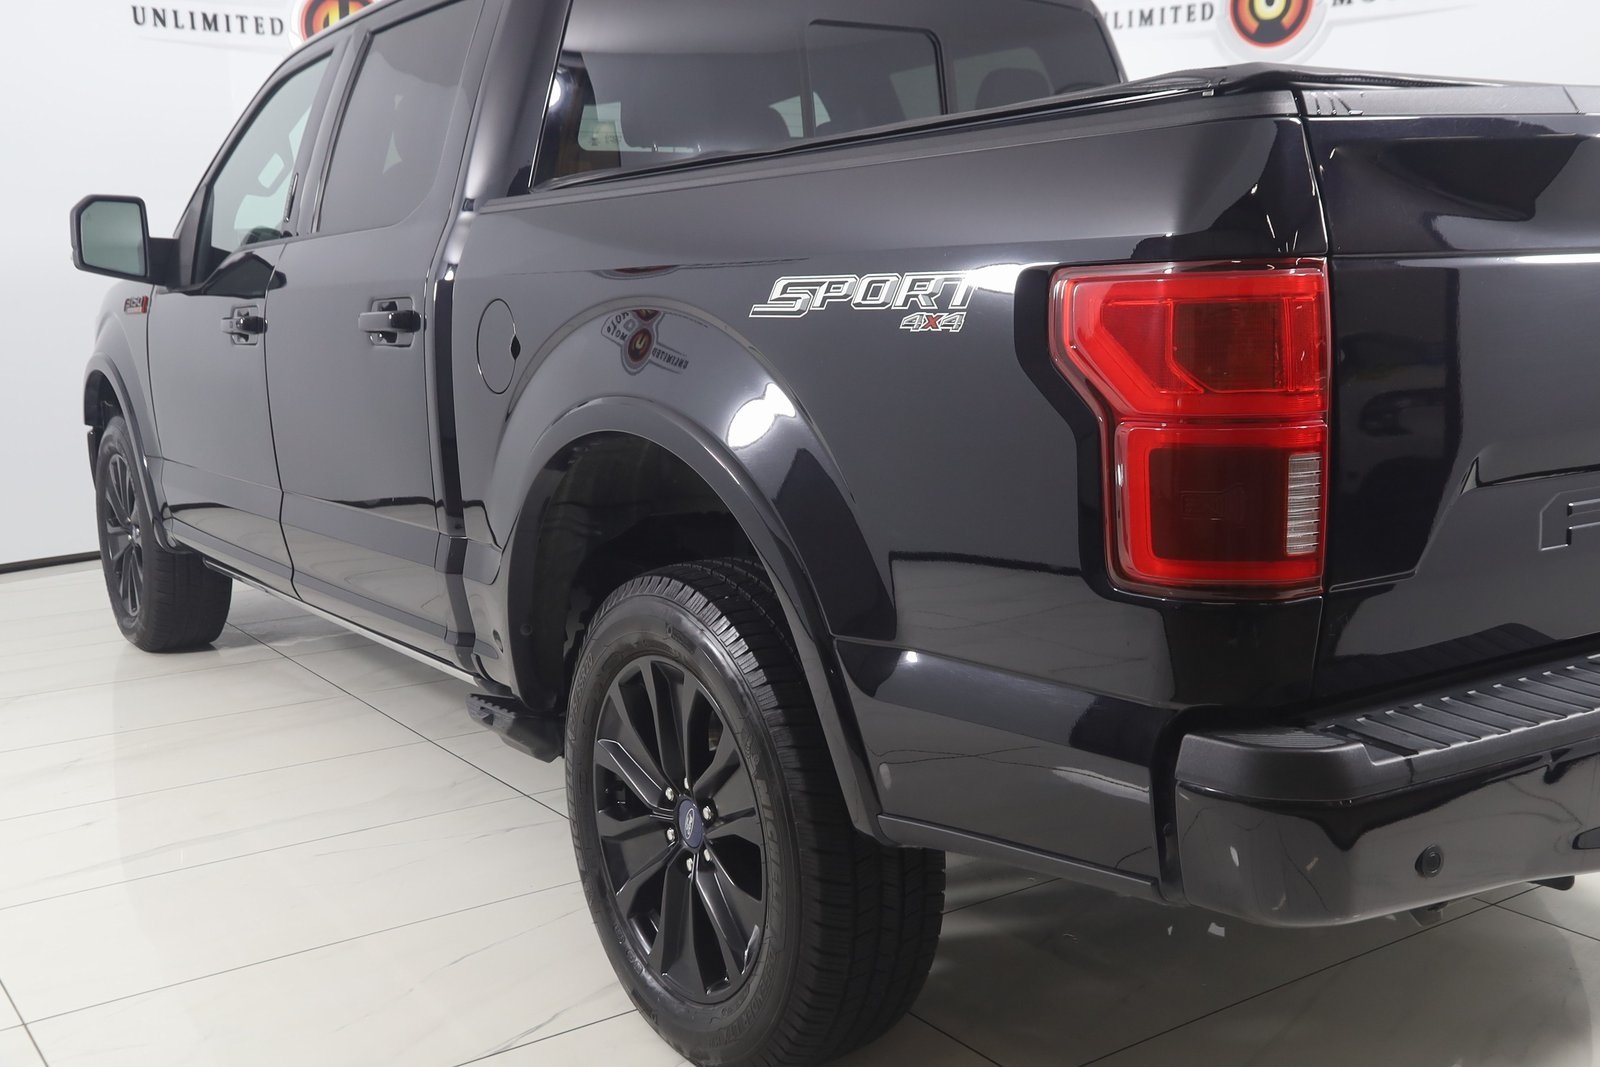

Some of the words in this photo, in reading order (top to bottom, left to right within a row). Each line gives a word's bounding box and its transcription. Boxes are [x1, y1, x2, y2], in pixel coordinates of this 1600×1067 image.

[131, 5, 285, 36] UNLIMITED
[1103, 2, 1214, 29] LIMITED
[749, 271, 978, 318] SPORT
